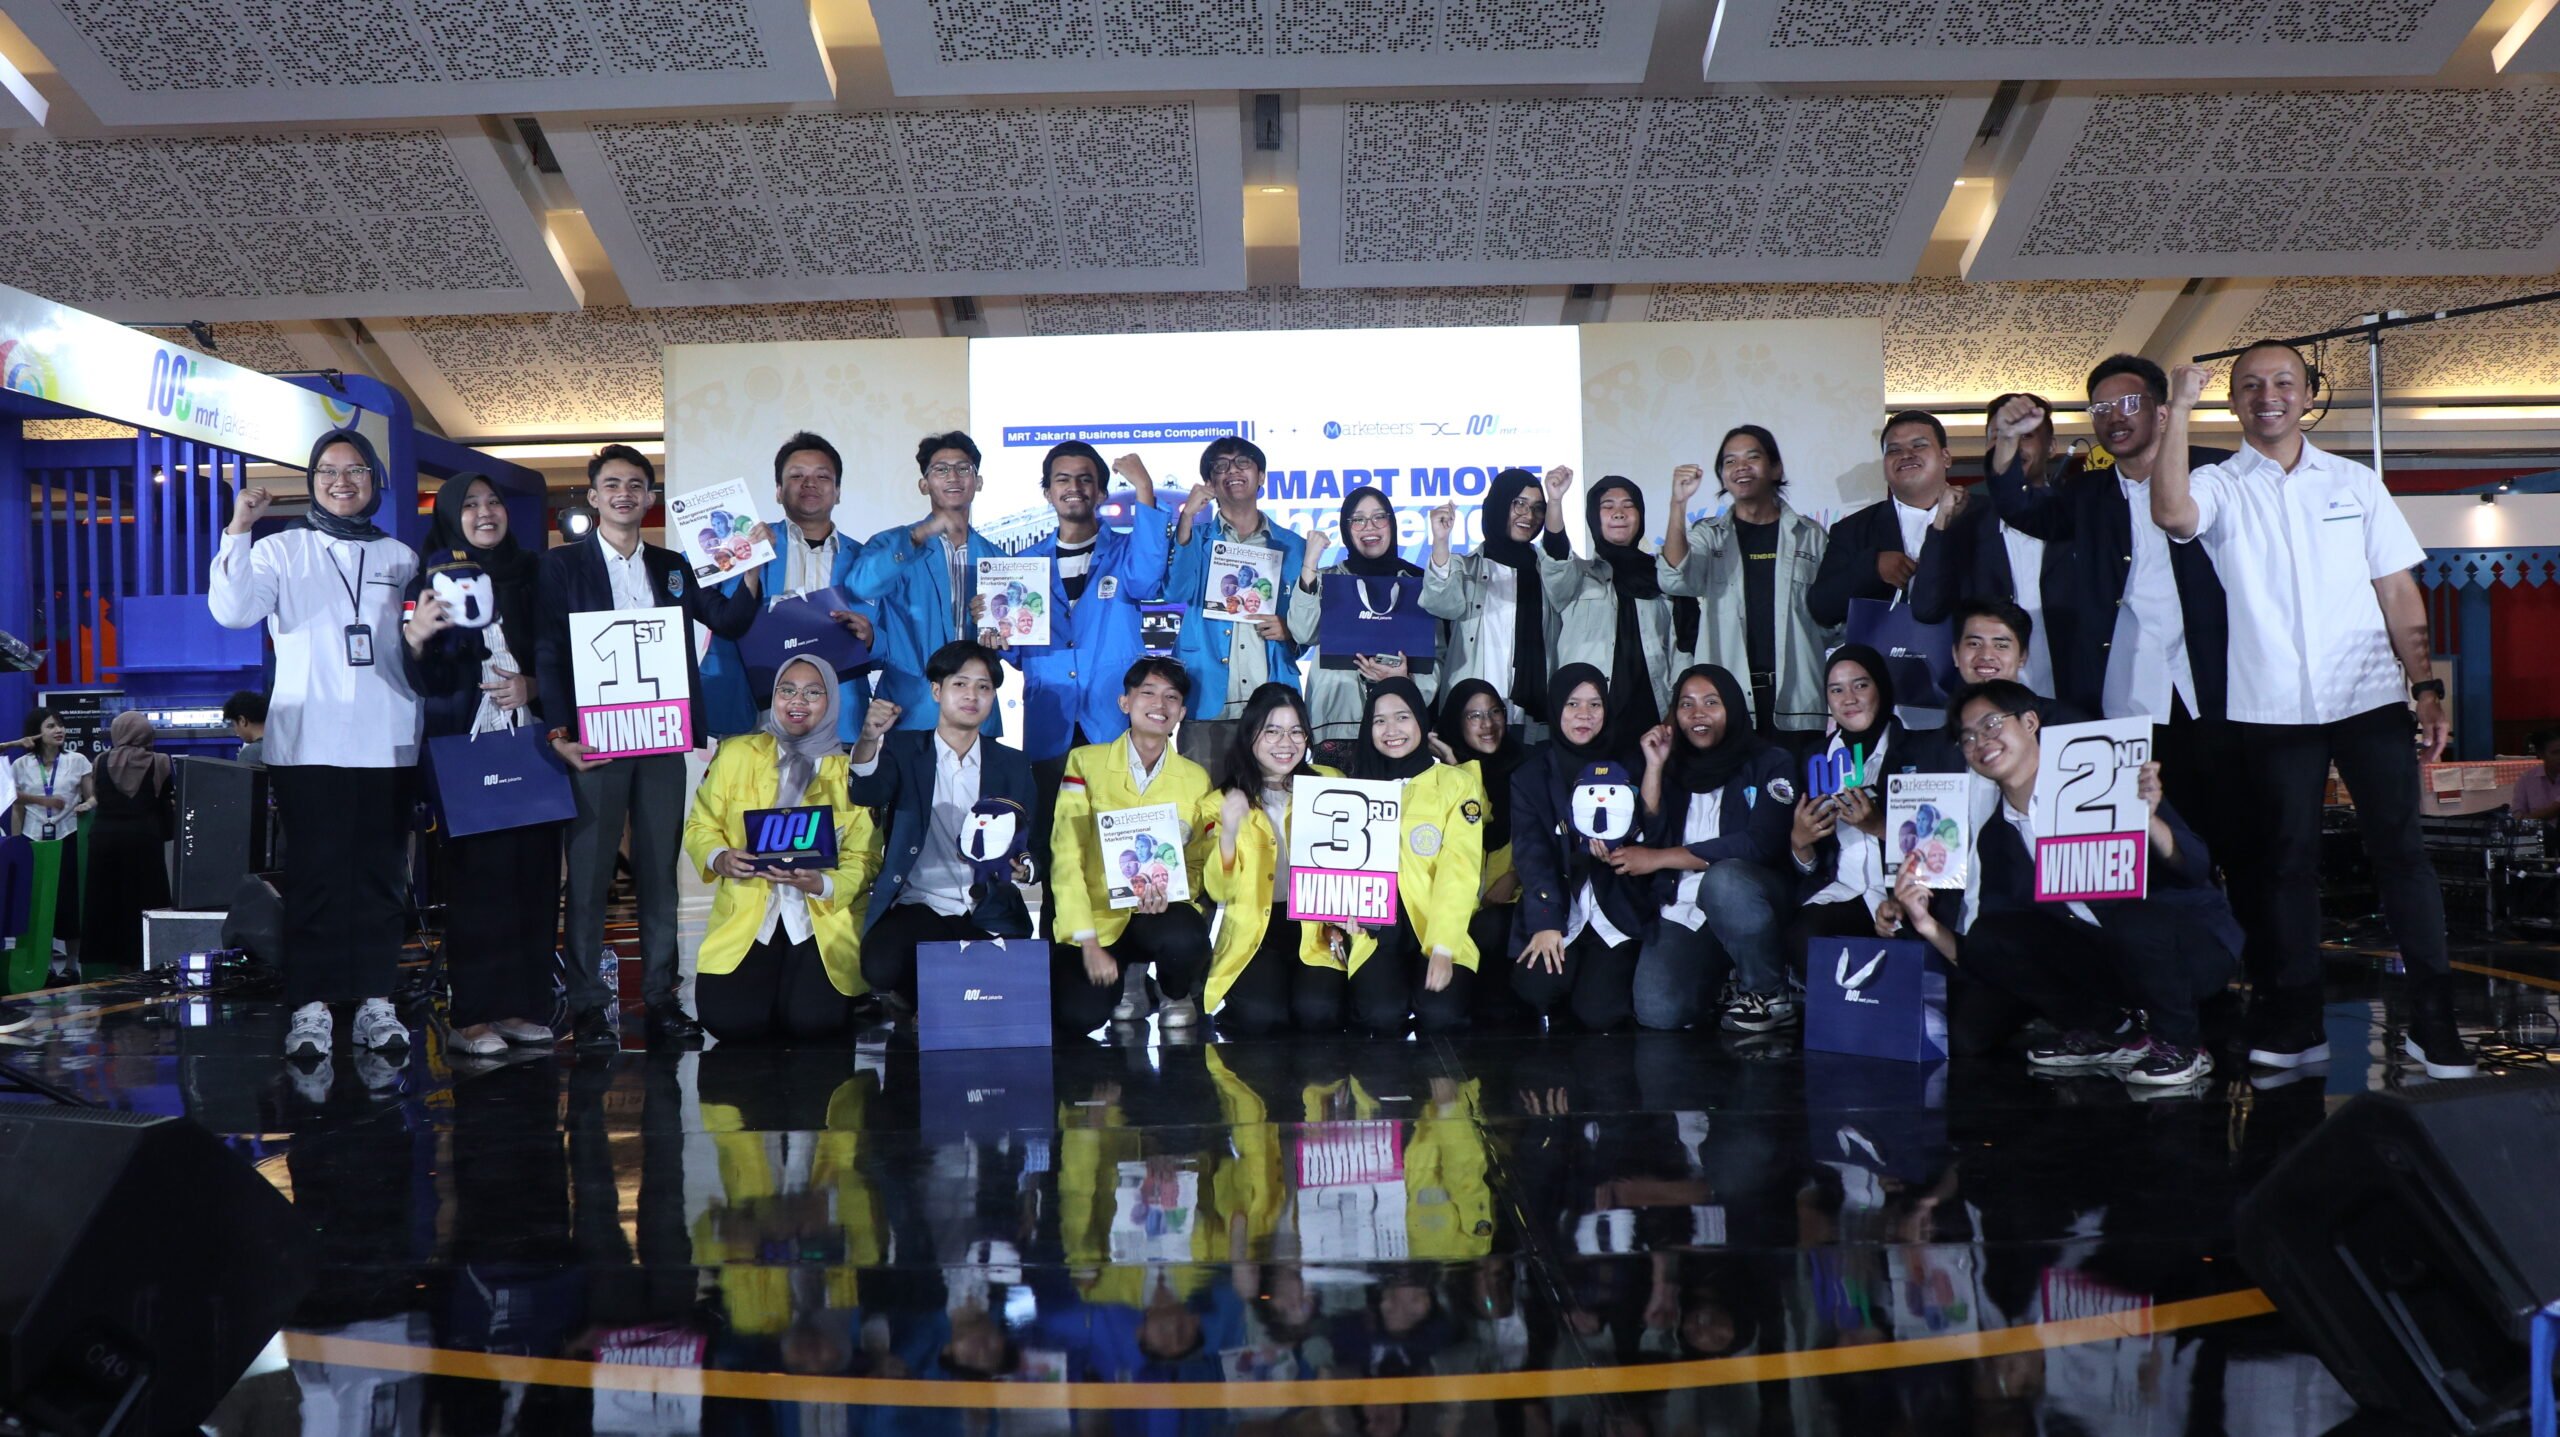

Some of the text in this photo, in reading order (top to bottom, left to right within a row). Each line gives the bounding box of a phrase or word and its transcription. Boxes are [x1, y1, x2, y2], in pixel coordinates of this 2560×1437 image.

[195, 406, 219, 429] mrt
[1007, 427, 1234, 442] MRT Jakarta Business Case Competition
[1323, 420, 1414, 440] Marketeers
[1257, 468, 1399, 500] MART
[671, 486, 736, 513] Marketeers
[679, 514, 709, 527] Marketing
[1214, 544, 1273, 561] Marketeers
[979, 561, 1039, 574] Marketeers
[583, 705, 685, 754] WINNER
[1889, 778, 1955, 794] Marketeers
[1101, 808, 1166, 829] Marketeers
[1103, 826, 1152, 838] Intergenerational
[1104, 834, 1133, 843] Marketing
[2040, 838, 2137, 895] WINNER
[1295, 871, 1390, 919] WINNER
